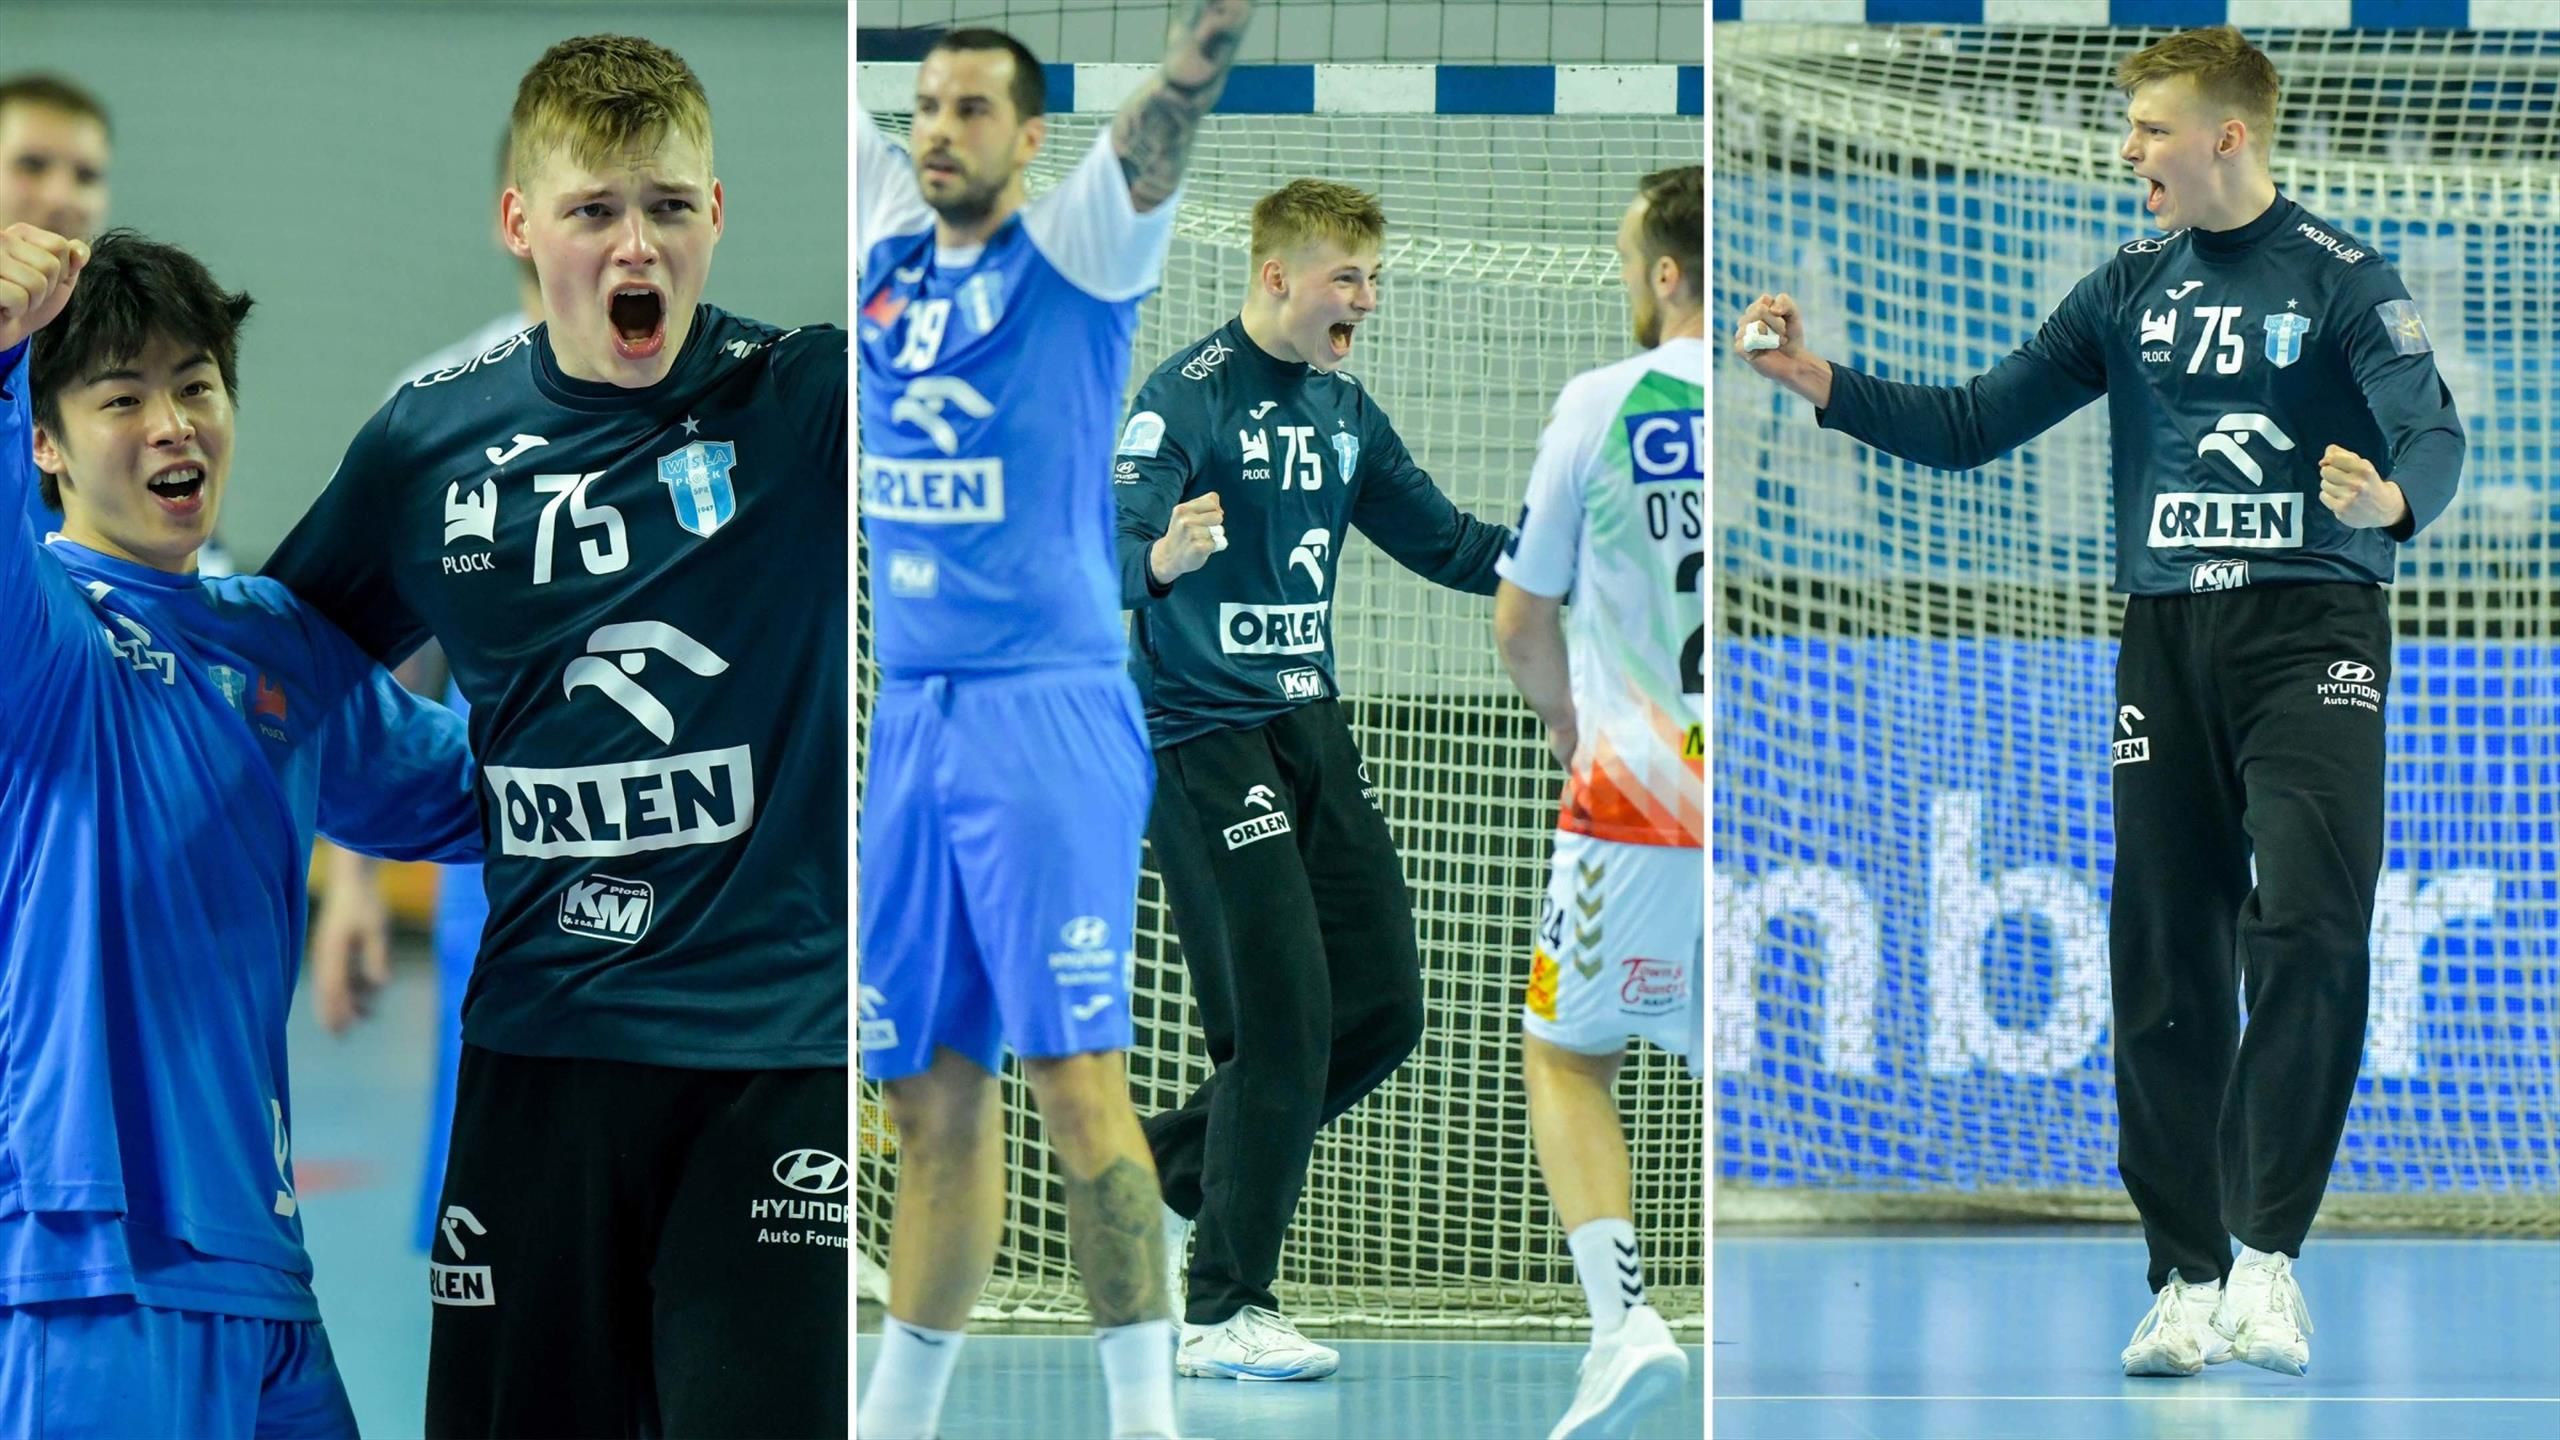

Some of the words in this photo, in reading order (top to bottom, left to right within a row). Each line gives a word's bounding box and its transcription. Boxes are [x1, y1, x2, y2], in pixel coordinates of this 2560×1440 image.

[893, 299, 952, 372] 19
[2186, 306, 2244, 375] 75
[1277, 426, 1322, 490] 75
[876, 470, 985, 509] RLEN
[533, 471, 630, 585] 75
[2159, 501, 2292, 540] ORLEN
[442, 551, 496, 575] PŁOCK
[2194, 563, 2245, 590] KM
[1229, 610, 1328, 646] ORLEN
[1283, 672, 1320, 697] KM
[2317, 683, 2380, 704] HYUNDAI
[2323, 697, 2349, 705] Auto
[2351, 697, 2378, 712] Forum
[505, 763, 736, 845] ORLEN
[1229, 814, 1288, 844] ORLEN
[565, 880, 648, 934] KM
[757, 1228, 801, 1243] Auto
